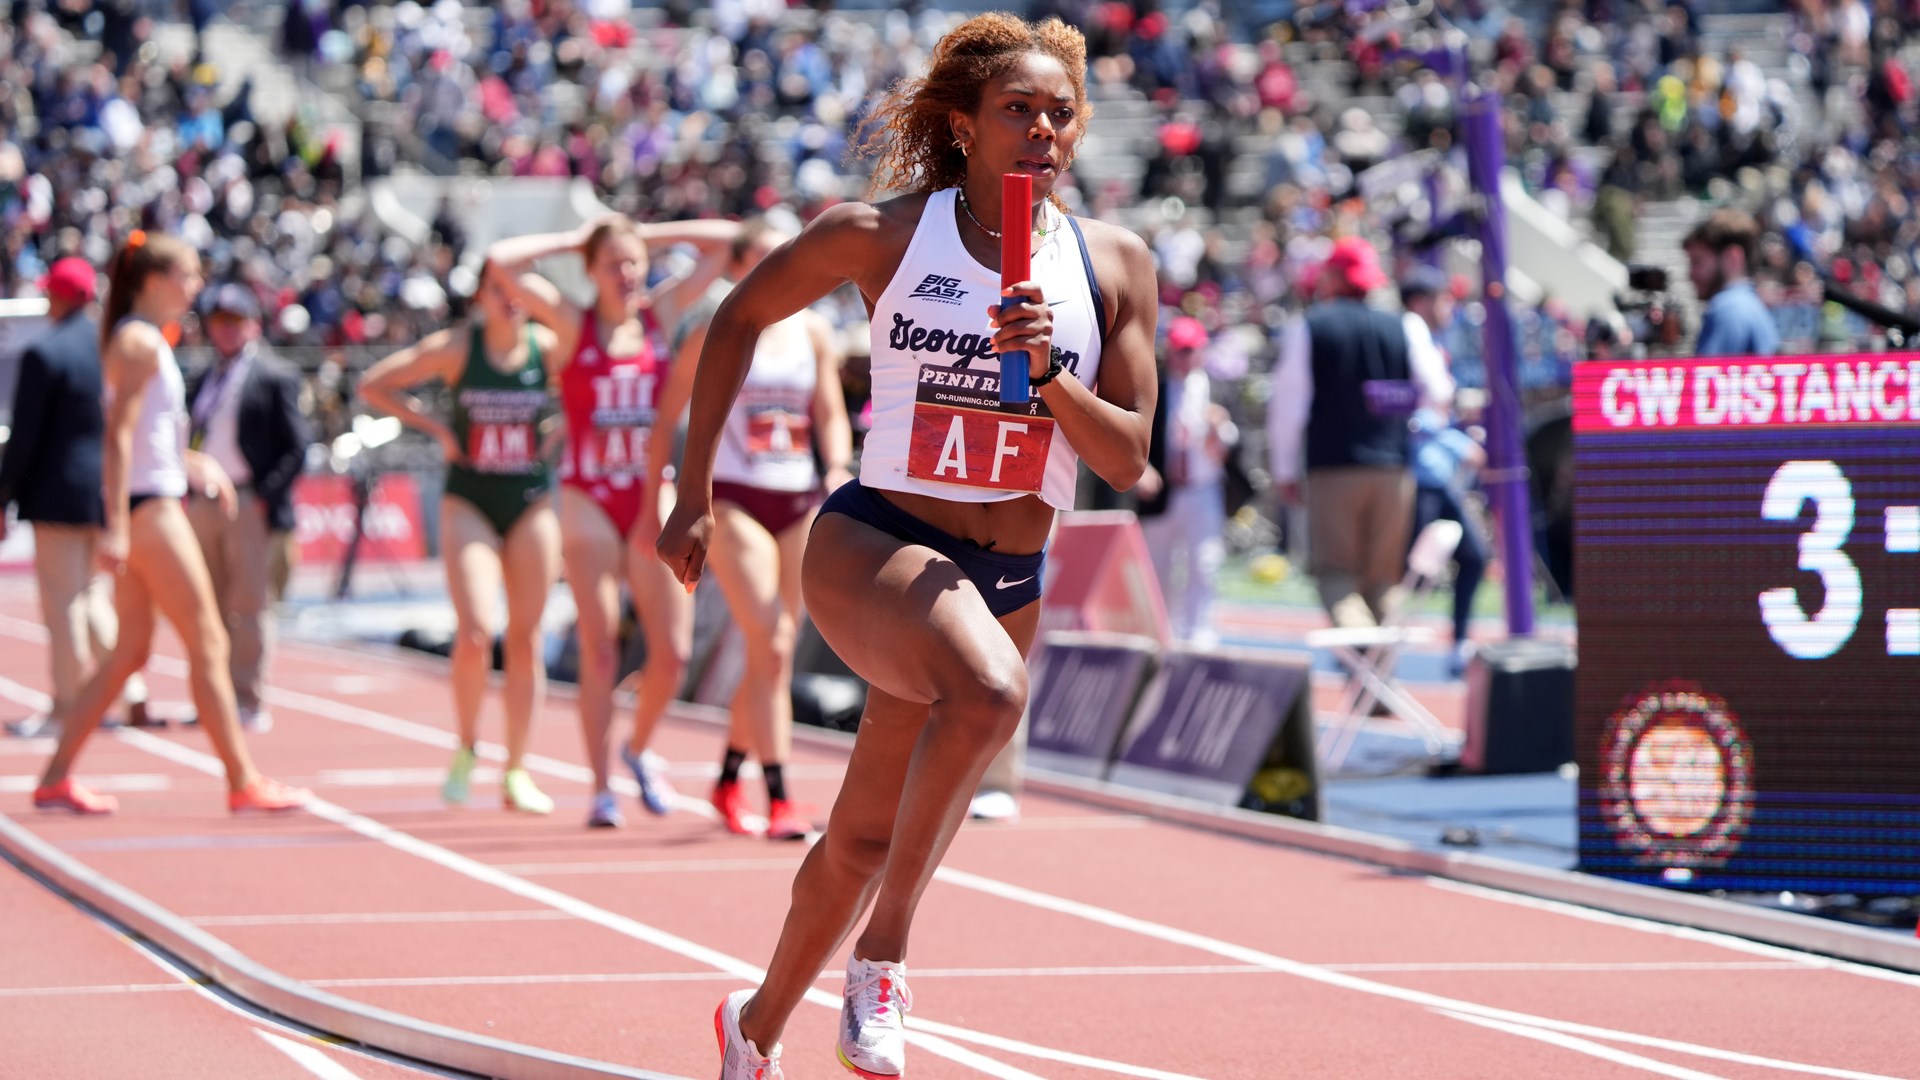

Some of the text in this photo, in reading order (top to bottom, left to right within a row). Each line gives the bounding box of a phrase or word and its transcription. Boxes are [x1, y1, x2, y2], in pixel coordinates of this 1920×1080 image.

[922, 273, 962, 288] BIG
[913, 283, 970, 299] EAST
[920, 370, 980, 390] PENN
[935, 392, 1001, 408] ON-RUNNING.COM
[1601, 366, 1685, 427] CW
[933, 415, 1028, 482] A F
